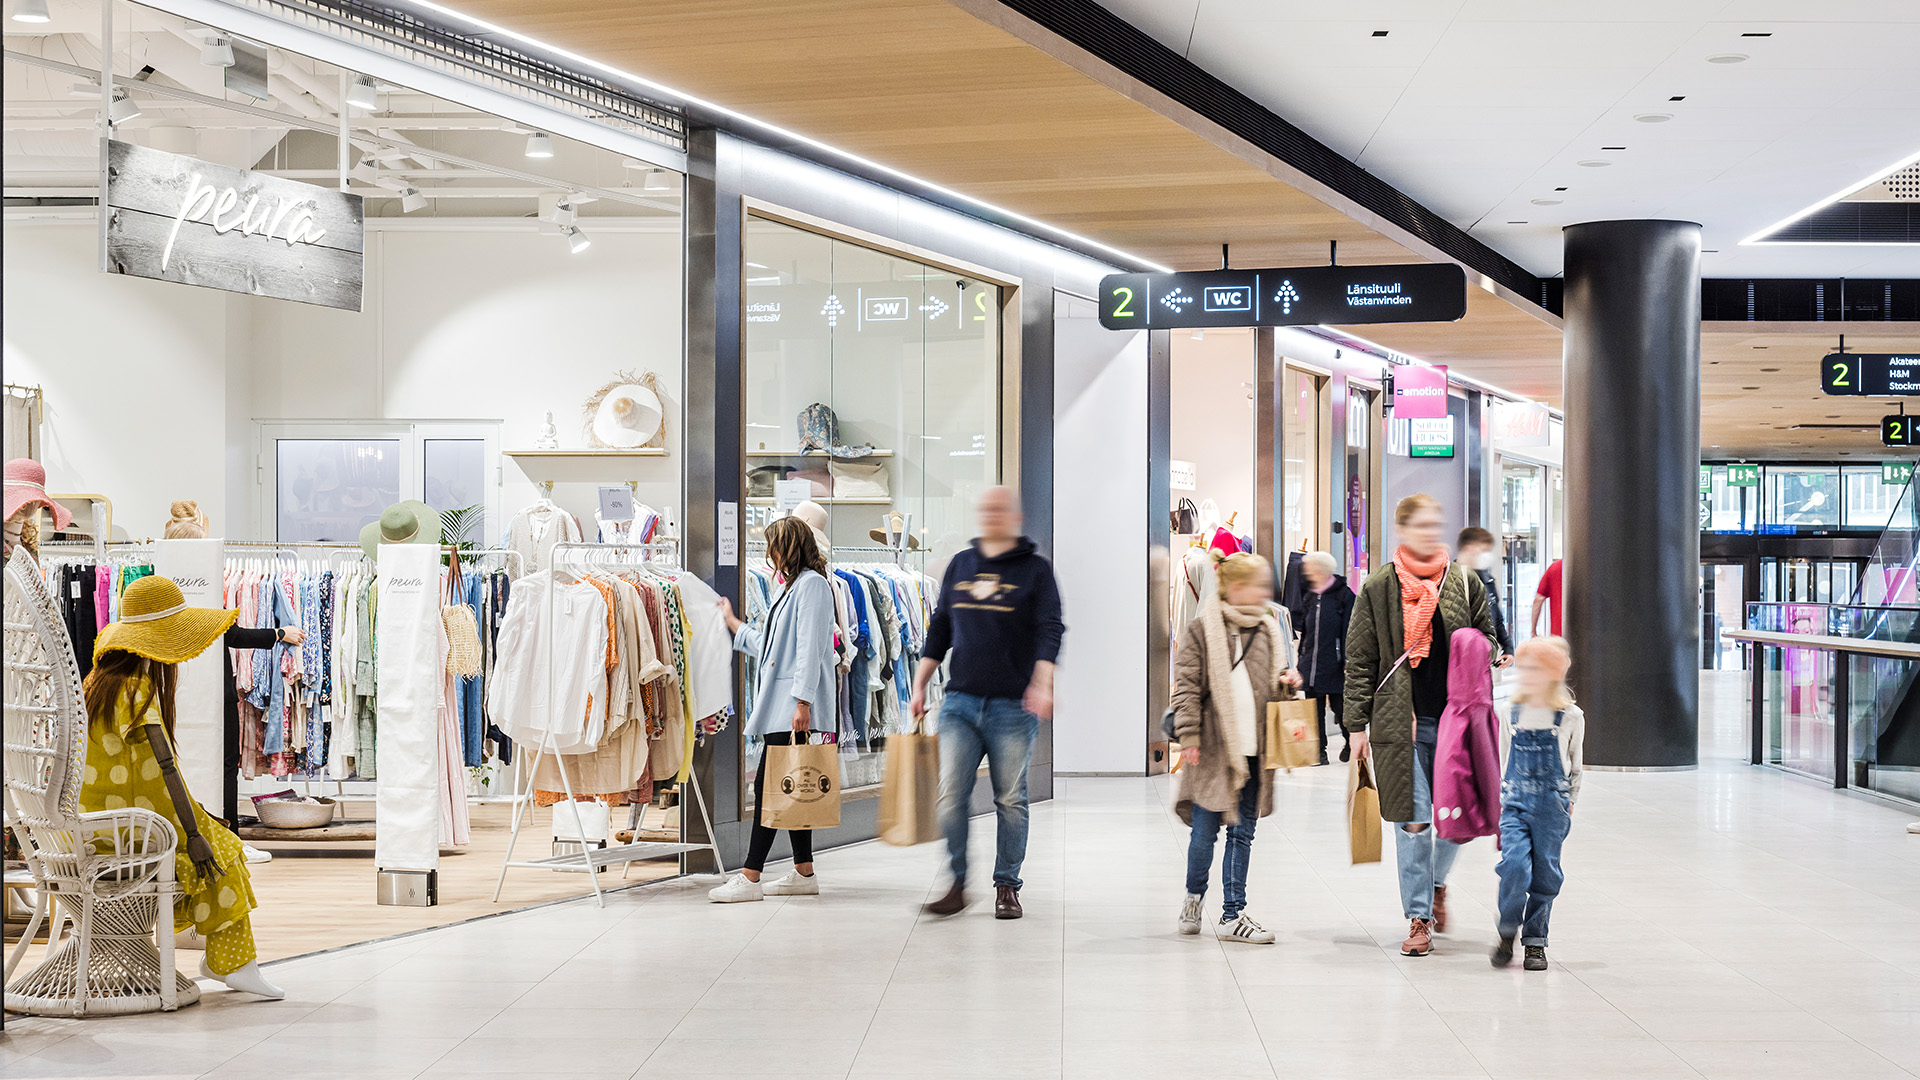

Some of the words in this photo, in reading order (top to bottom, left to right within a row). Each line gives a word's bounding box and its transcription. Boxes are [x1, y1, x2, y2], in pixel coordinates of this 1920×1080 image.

[162, 173, 327, 274] peura
[1347, 283, 1401, 295] Länsituuli
[1112, 287, 1134, 317] 2
[1213, 292, 1242, 306] WC
[1346, 295, 1412, 306] Västanvinden
[1889, 357, 1920, 366] Akatee
[1833, 363, 1850, 386] 2
[1889, 369, 1910, 378] H&M
[1404, 386, 1444, 397] emotion
[1506, 410, 1546, 438] H&M
[1890, 421, 1903, 439] 2
[385, 577, 424, 594] peura
